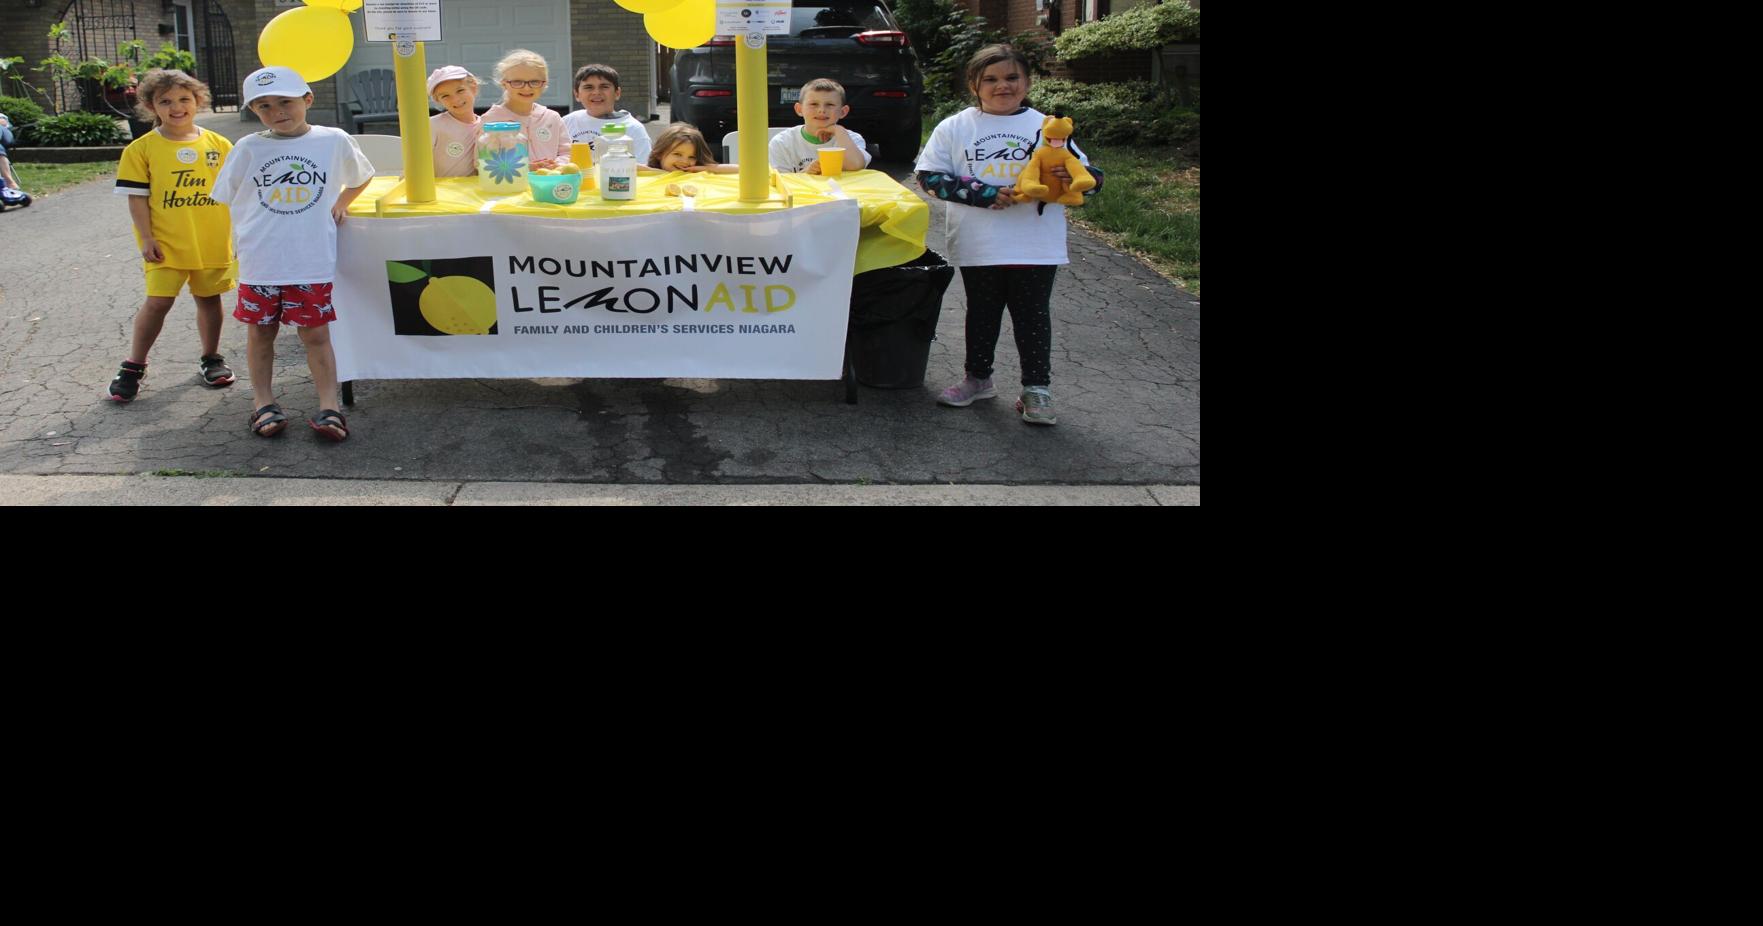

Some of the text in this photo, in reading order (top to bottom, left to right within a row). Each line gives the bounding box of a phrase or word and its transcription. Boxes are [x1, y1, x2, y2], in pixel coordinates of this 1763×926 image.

[260, 155, 318, 173] MOUNTAINVIEW
[171, 169, 206, 187] Tim
[253, 170, 326, 187] LEMON
[163, 190, 219, 209] Horton
[269, 186, 312, 204] AID
[508, 253, 793, 278] MOUNTAINVIEW
[514, 324, 796, 335] FAMILY AND CHILDREN'S SERVICES NIAGARA
